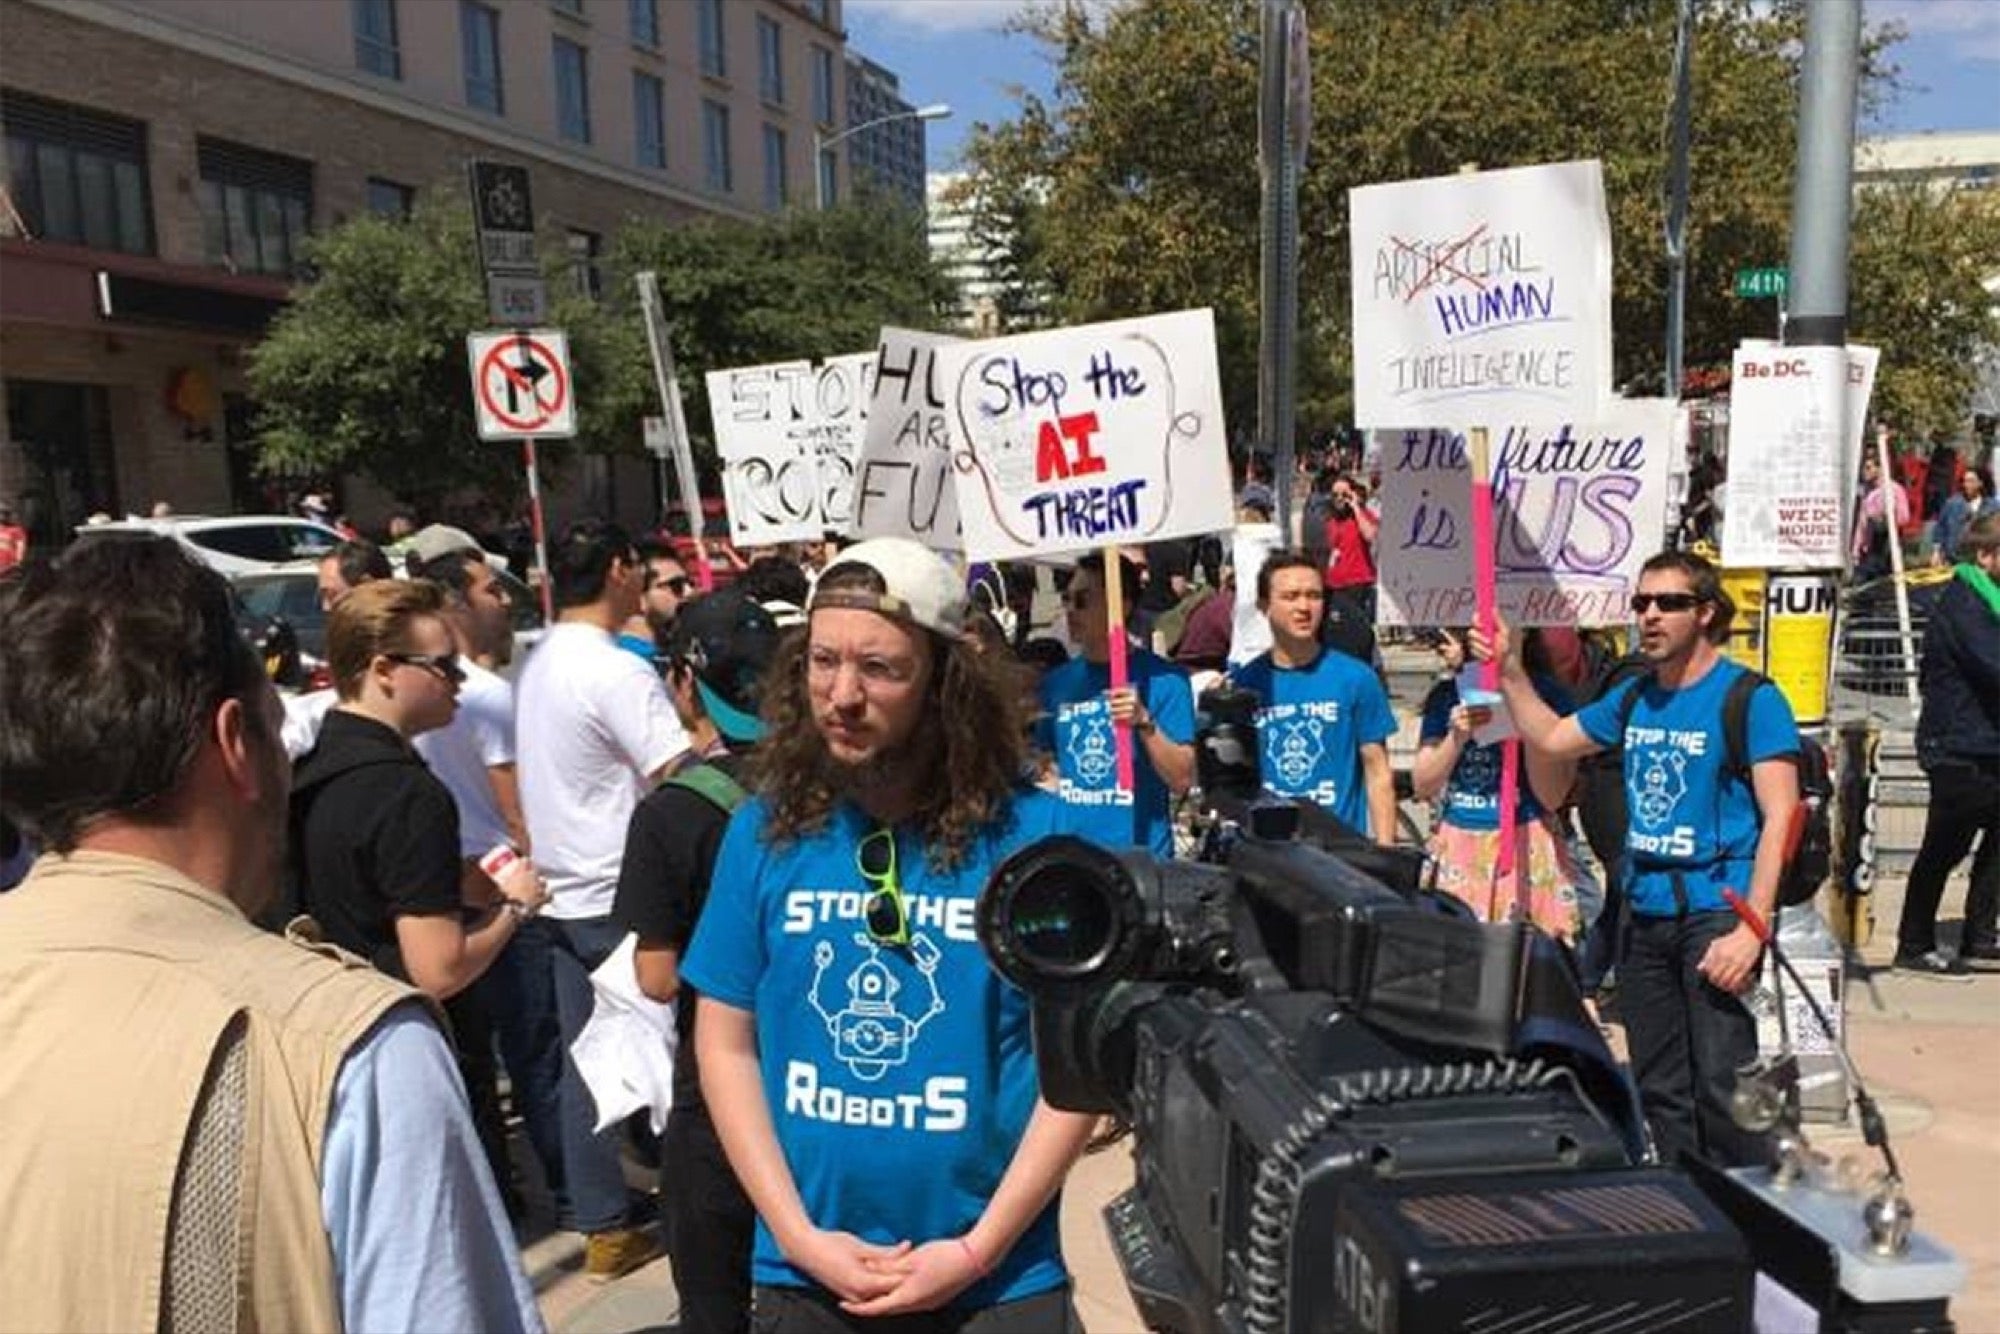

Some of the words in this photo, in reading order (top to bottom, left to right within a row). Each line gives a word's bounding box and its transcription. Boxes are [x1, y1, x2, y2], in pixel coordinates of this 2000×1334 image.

[1436, 277, 1554, 335] HUMAN
[1749, 271, 1785, 293] 4th
[979, 356, 1067, 417] Stop
[1084, 350, 1147, 401] the
[1389, 349, 1575, 395] INTELLIGENCE
[895, 410, 951, 452] AR
[1036, 410, 1107, 484] AI
[1399, 428, 1472, 472] the
[1491, 424, 1646, 502] future
[858, 460, 963, 535] FU
[1022, 478, 1146, 539] THREAT
[1400, 488, 1460, 549] is
[1493, 474, 1643, 576] US
[1301, 702, 1338, 722] THE
[1668, 730, 1707, 756] THE
[785, 1060, 968, 1132] ROBOTS
